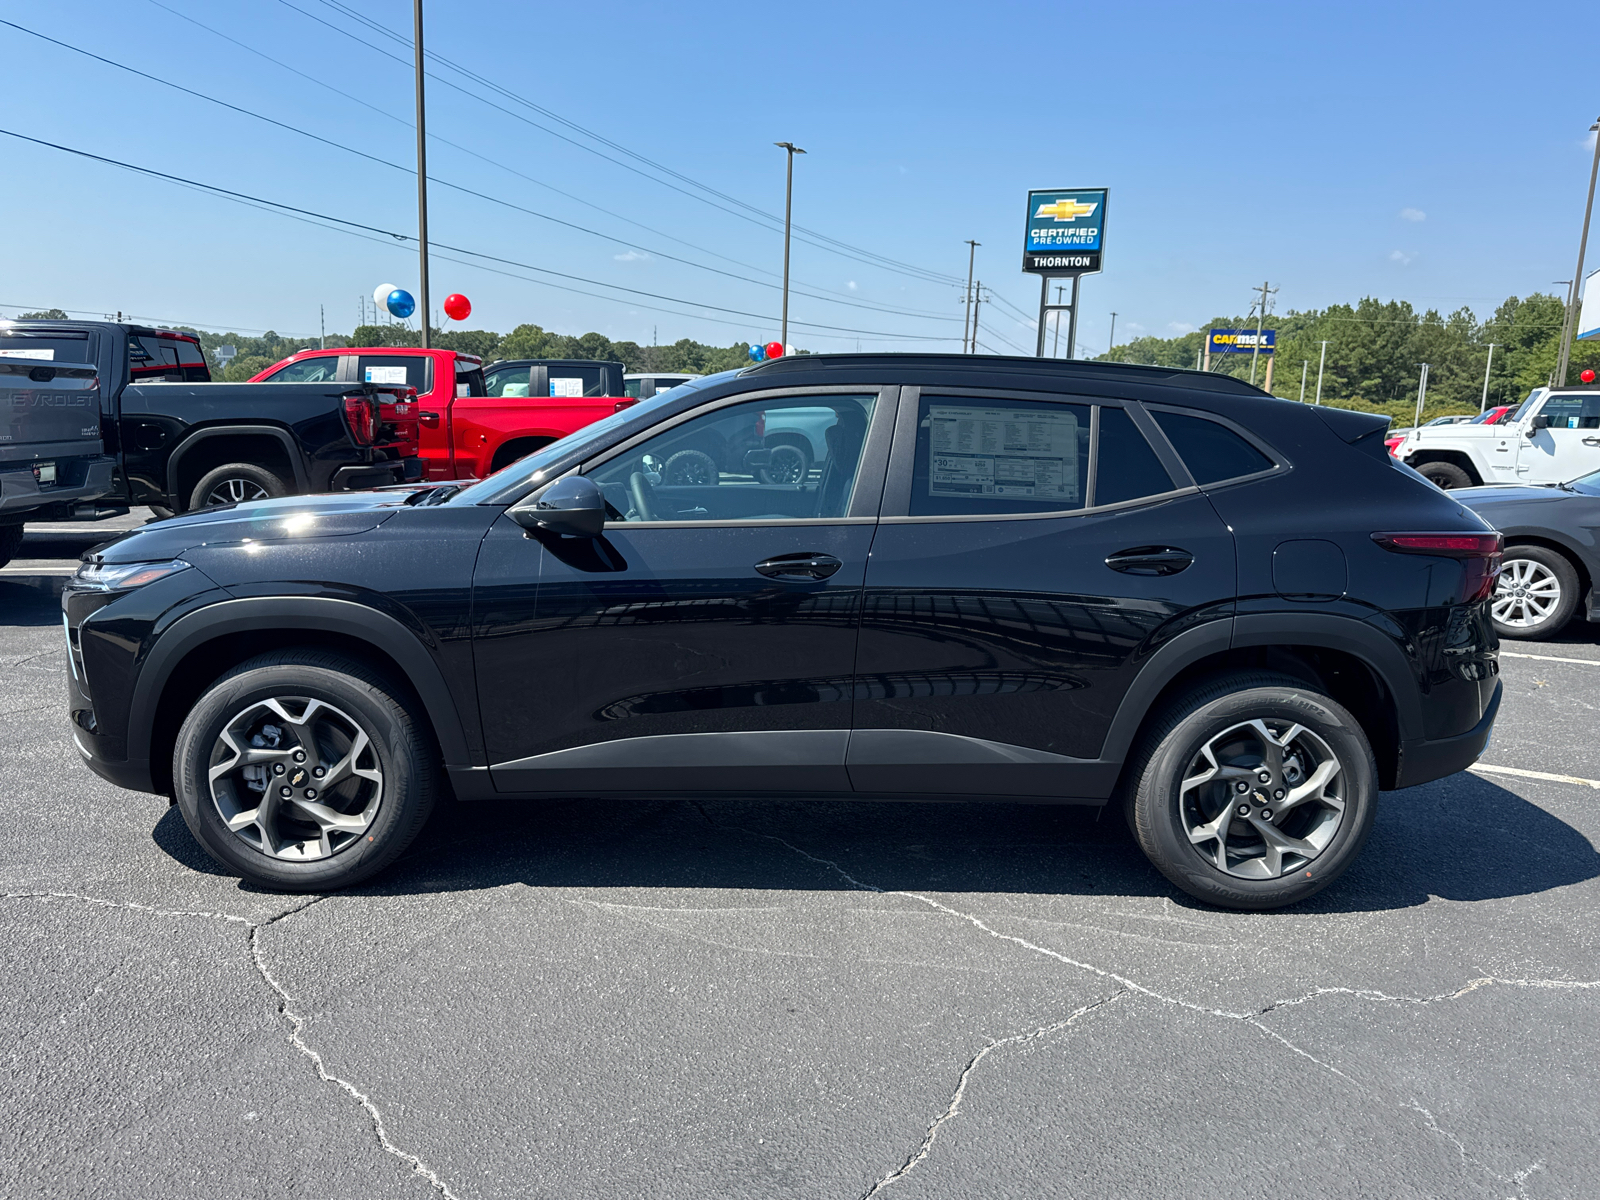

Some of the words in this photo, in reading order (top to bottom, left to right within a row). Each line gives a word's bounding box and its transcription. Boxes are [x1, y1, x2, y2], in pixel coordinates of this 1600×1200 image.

[1031, 228, 1098, 237] CERTIFIED
[1033, 236, 1094, 245] PRE-OWNED
[1033, 257, 1090, 267] THORNTON
[1296, 701, 1326, 717] HP2
